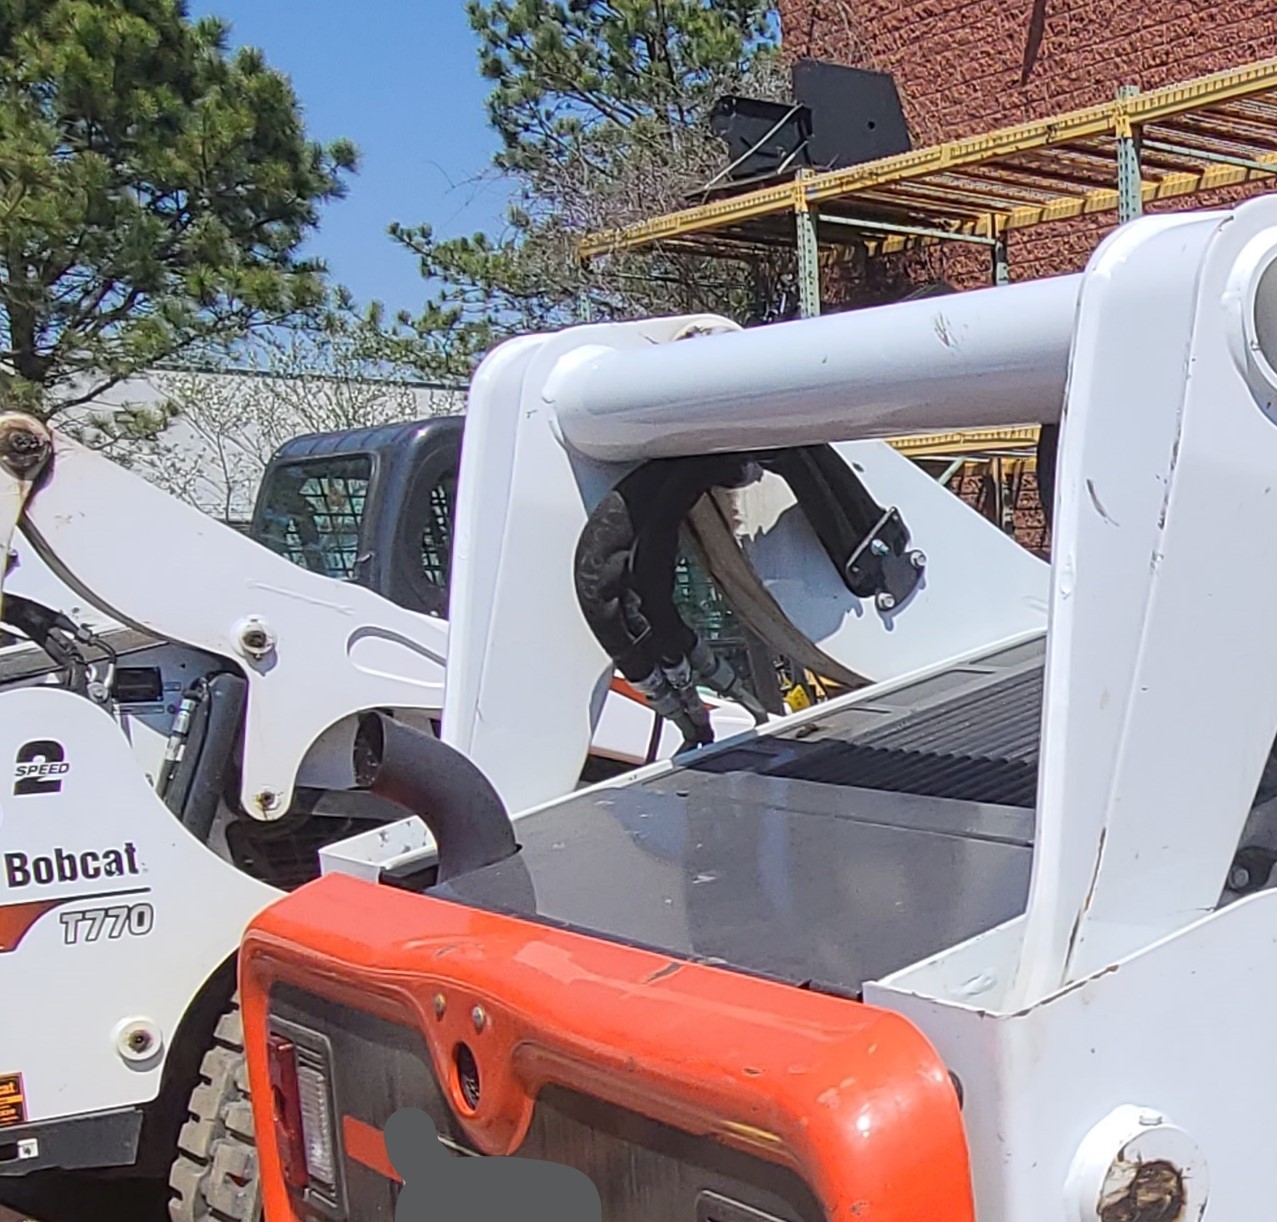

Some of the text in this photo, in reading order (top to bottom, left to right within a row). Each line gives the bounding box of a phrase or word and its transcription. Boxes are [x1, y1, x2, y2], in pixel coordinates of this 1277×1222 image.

[13, 740, 64, 796] 2
[15, 762, 70, 777] SPEED
[4, 842, 139, 888] Bobcat
[59, 902, 154, 945] T770
